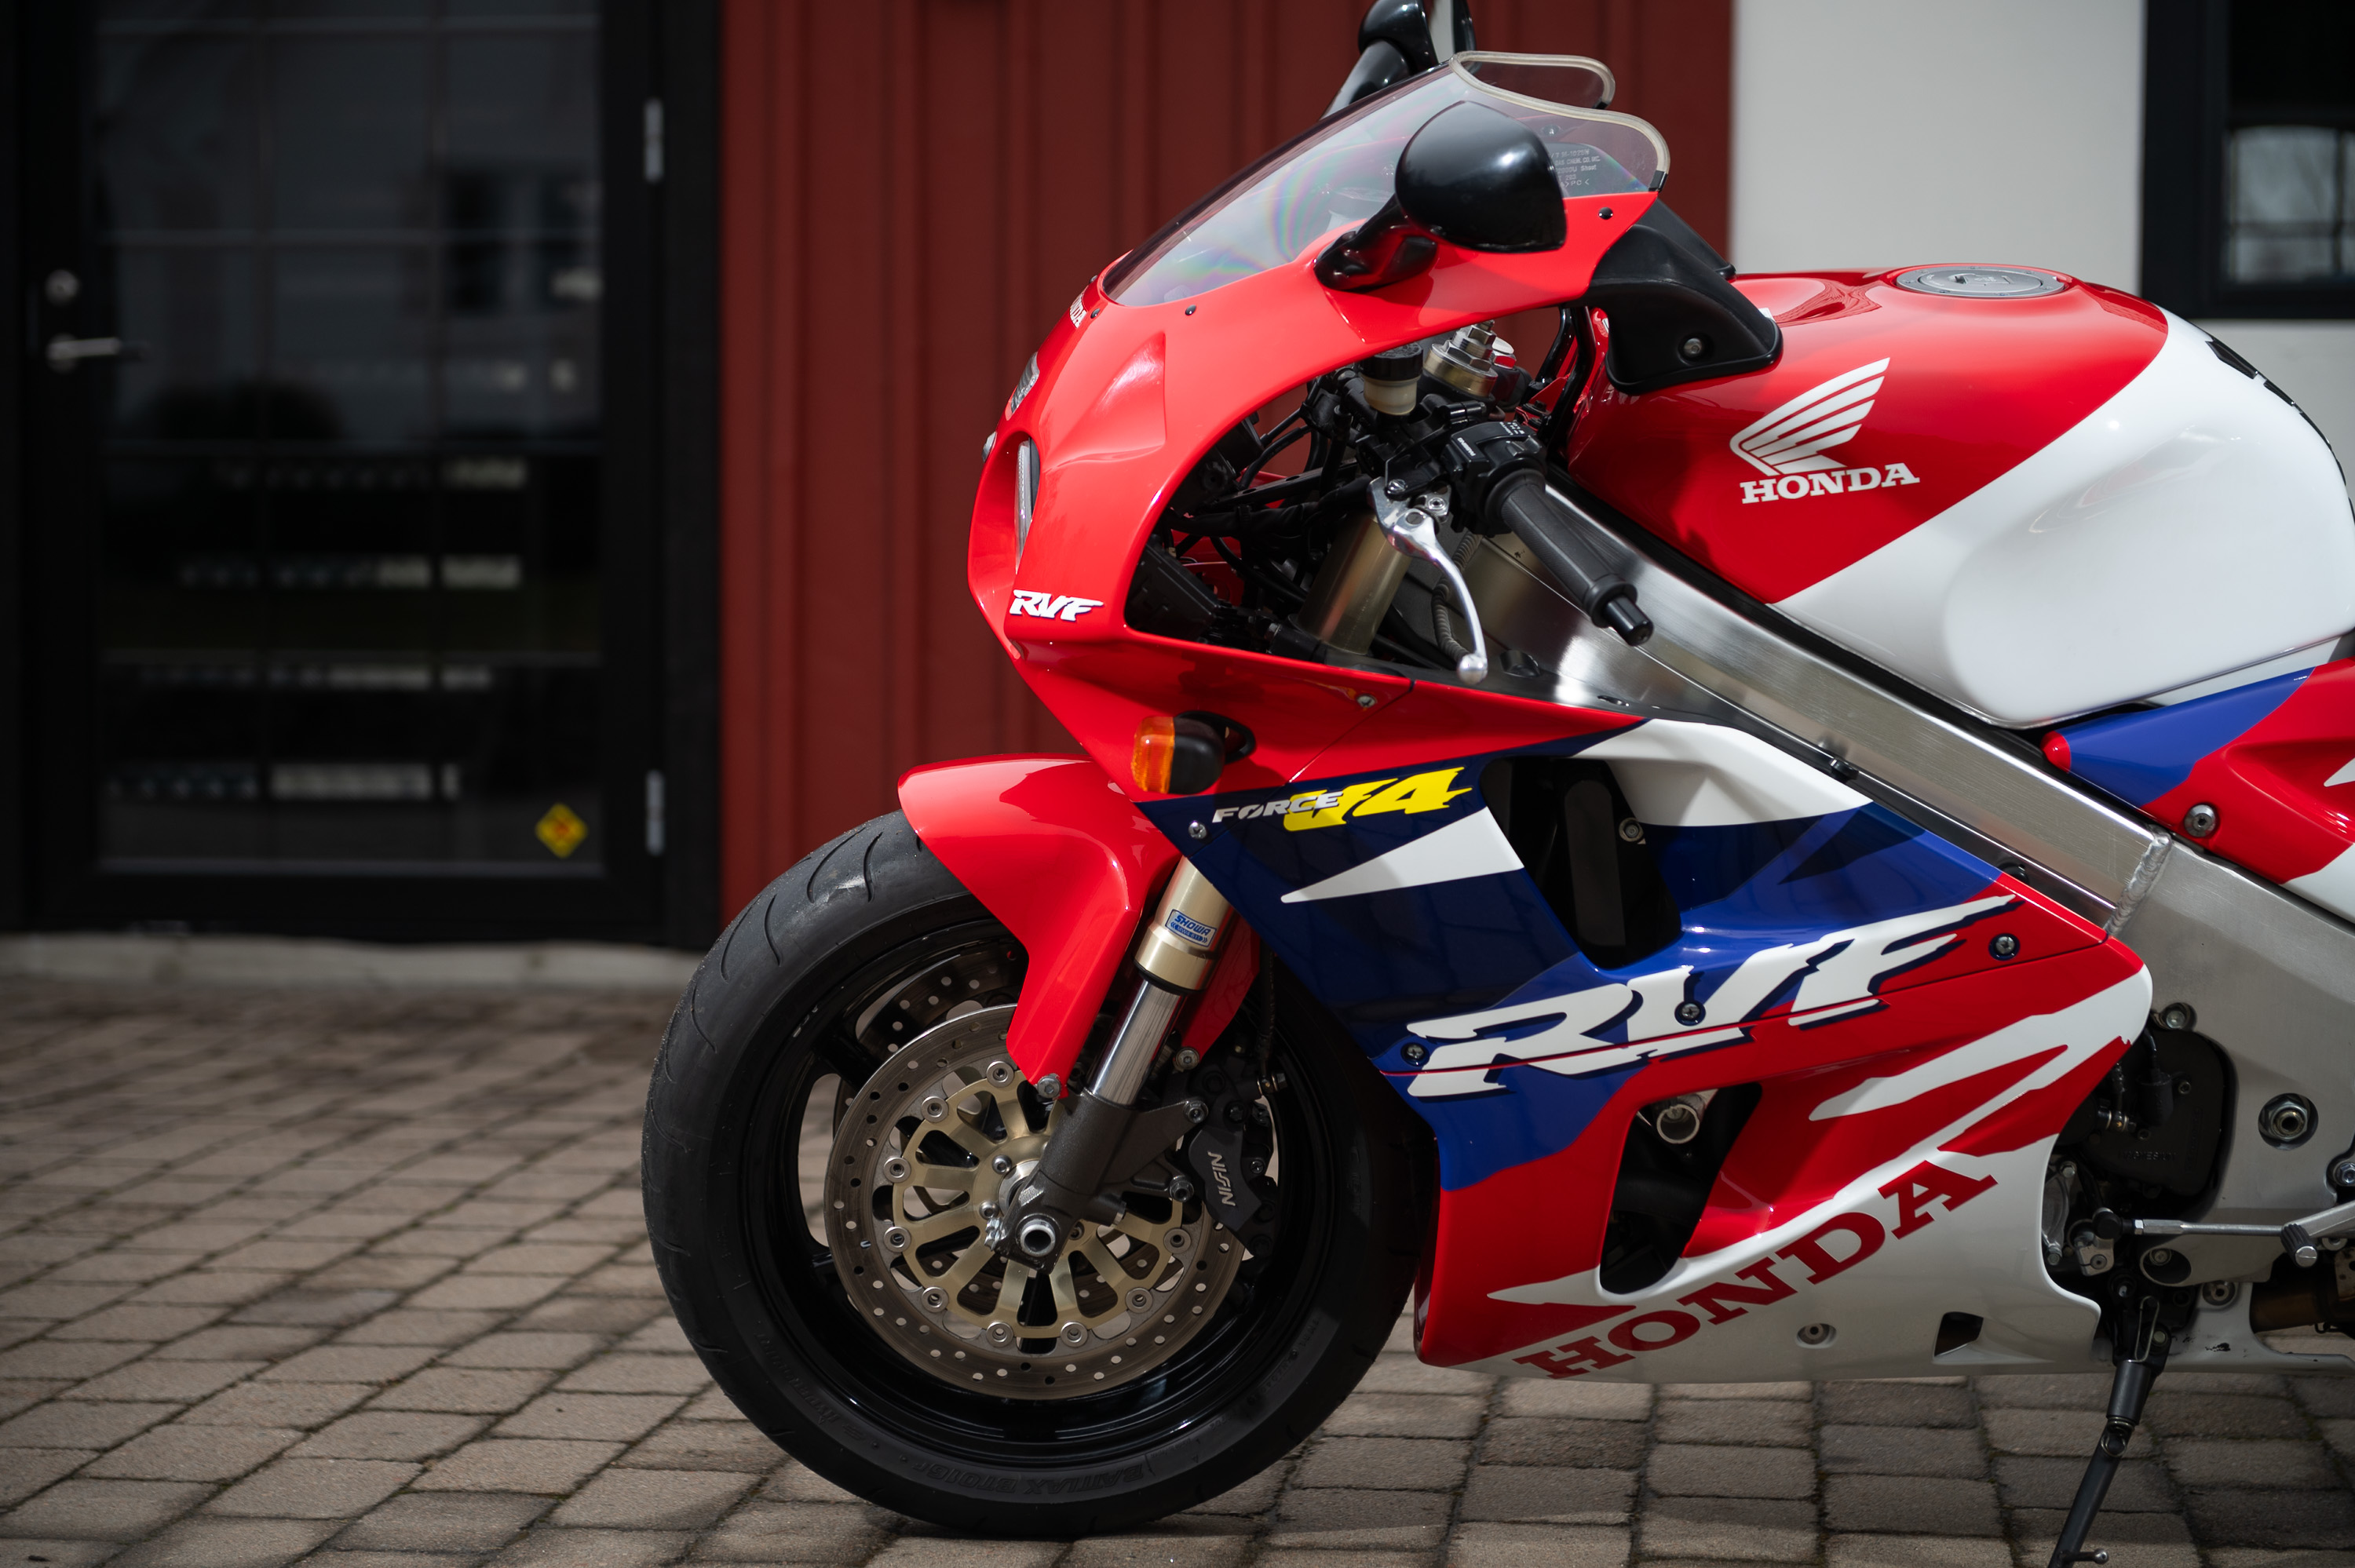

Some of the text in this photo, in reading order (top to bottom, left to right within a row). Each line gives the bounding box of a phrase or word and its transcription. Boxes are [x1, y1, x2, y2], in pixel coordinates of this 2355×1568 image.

[1740, 462, 1920, 504] HONDA
[1010, 589, 1104, 622] RVF
[1212, 767, 1473, 832] FORCE V4
[1174, 914, 1211, 936] SHOWA
[1407, 894, 2017, 1097] RVF
[1512, 1159, 1999, 1380] HONDA
